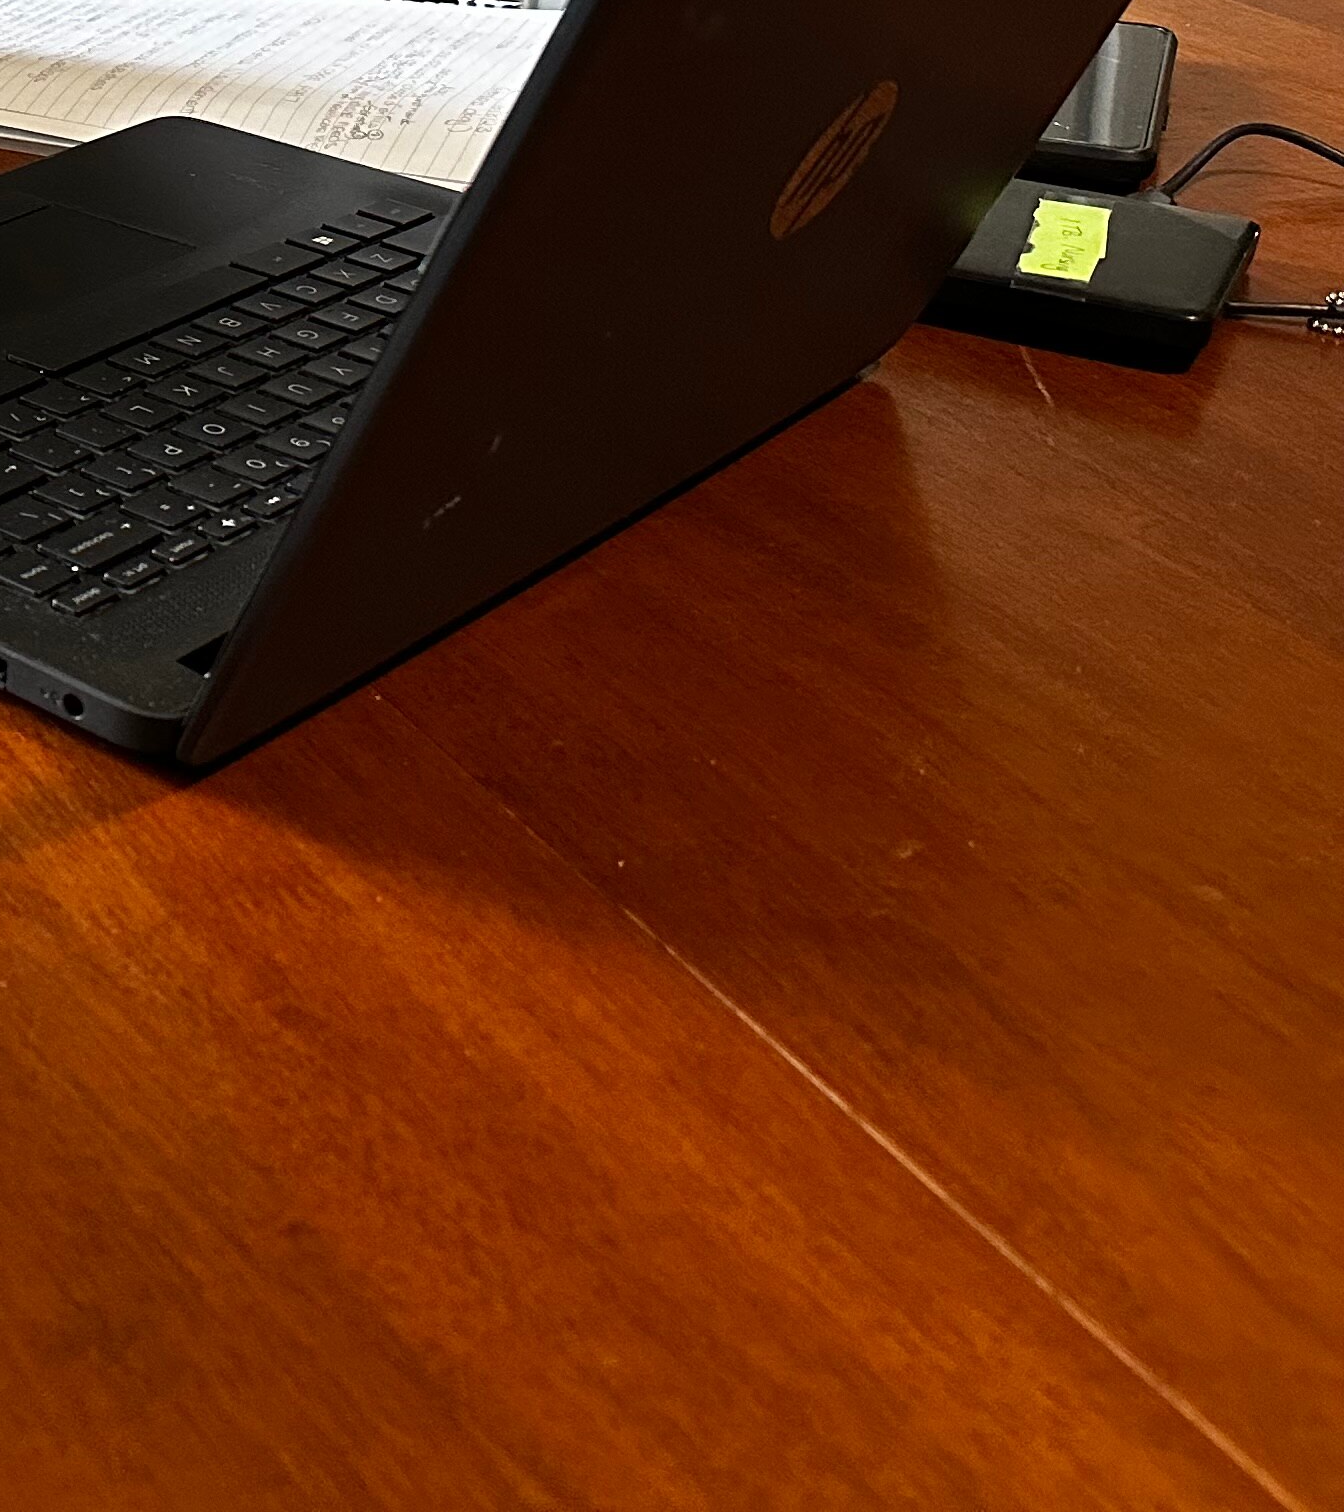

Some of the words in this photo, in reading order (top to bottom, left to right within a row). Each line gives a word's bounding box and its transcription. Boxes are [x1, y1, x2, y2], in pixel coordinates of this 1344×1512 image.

[370, 252, 393, 264] Z
[337, 268, 356, 279] X
[296, 285, 317, 295] C
[375, 294, 397, 305] D
[260, 300, 282, 311] V
[218, 317, 242, 328] B
[341, 313, 359, 323] F
[296, 329, 318, 340] G
[177, 335, 201, 347] N
[255, 346, 281, 359] H
[133, 353, 161, 366] M
[217, 365, 235, 377] J
[330, 365, 353, 376] Y
[173, 384, 199, 397] K
[287, 383, 312, 396] U
[129, 404, 155, 414] L
[201, 423, 226, 436] O
[164, 444, 183, 456] P
